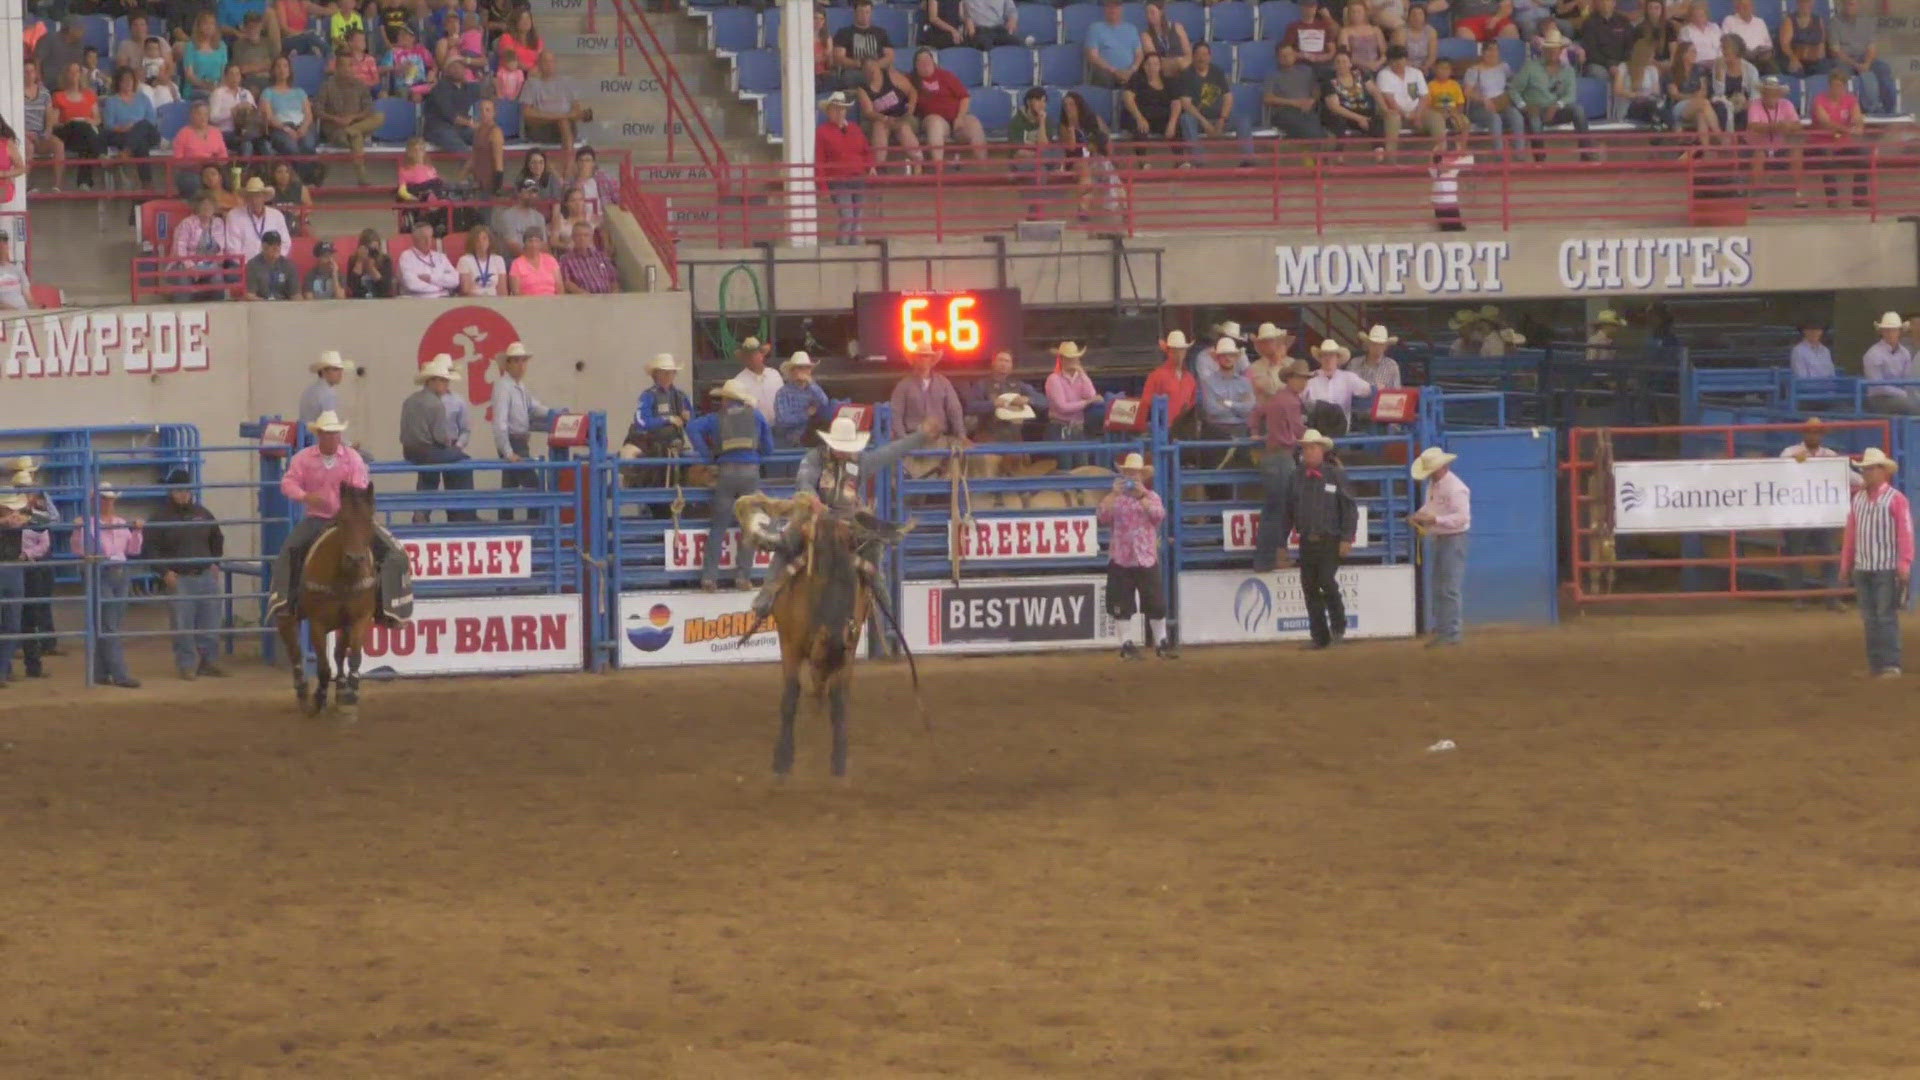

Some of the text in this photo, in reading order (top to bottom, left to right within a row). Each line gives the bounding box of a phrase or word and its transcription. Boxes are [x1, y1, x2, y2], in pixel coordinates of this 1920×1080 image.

[577, 37, 608, 48] ROW
[601, 80, 659, 91] ROW CC
[622, 124, 654, 135] ROW
[1275, 236, 1752, 295] MONFORT CHUTES
[902, 297, 979, 352] 6.6
[0, 310, 209, 378] AMPEDE
[1654, 479, 1840, 509] Banner Health
[402, 540, 523, 576] REELEY
[950, 595, 1085, 629] BESTWAY
[361, 614, 567, 657] OOT BARN
